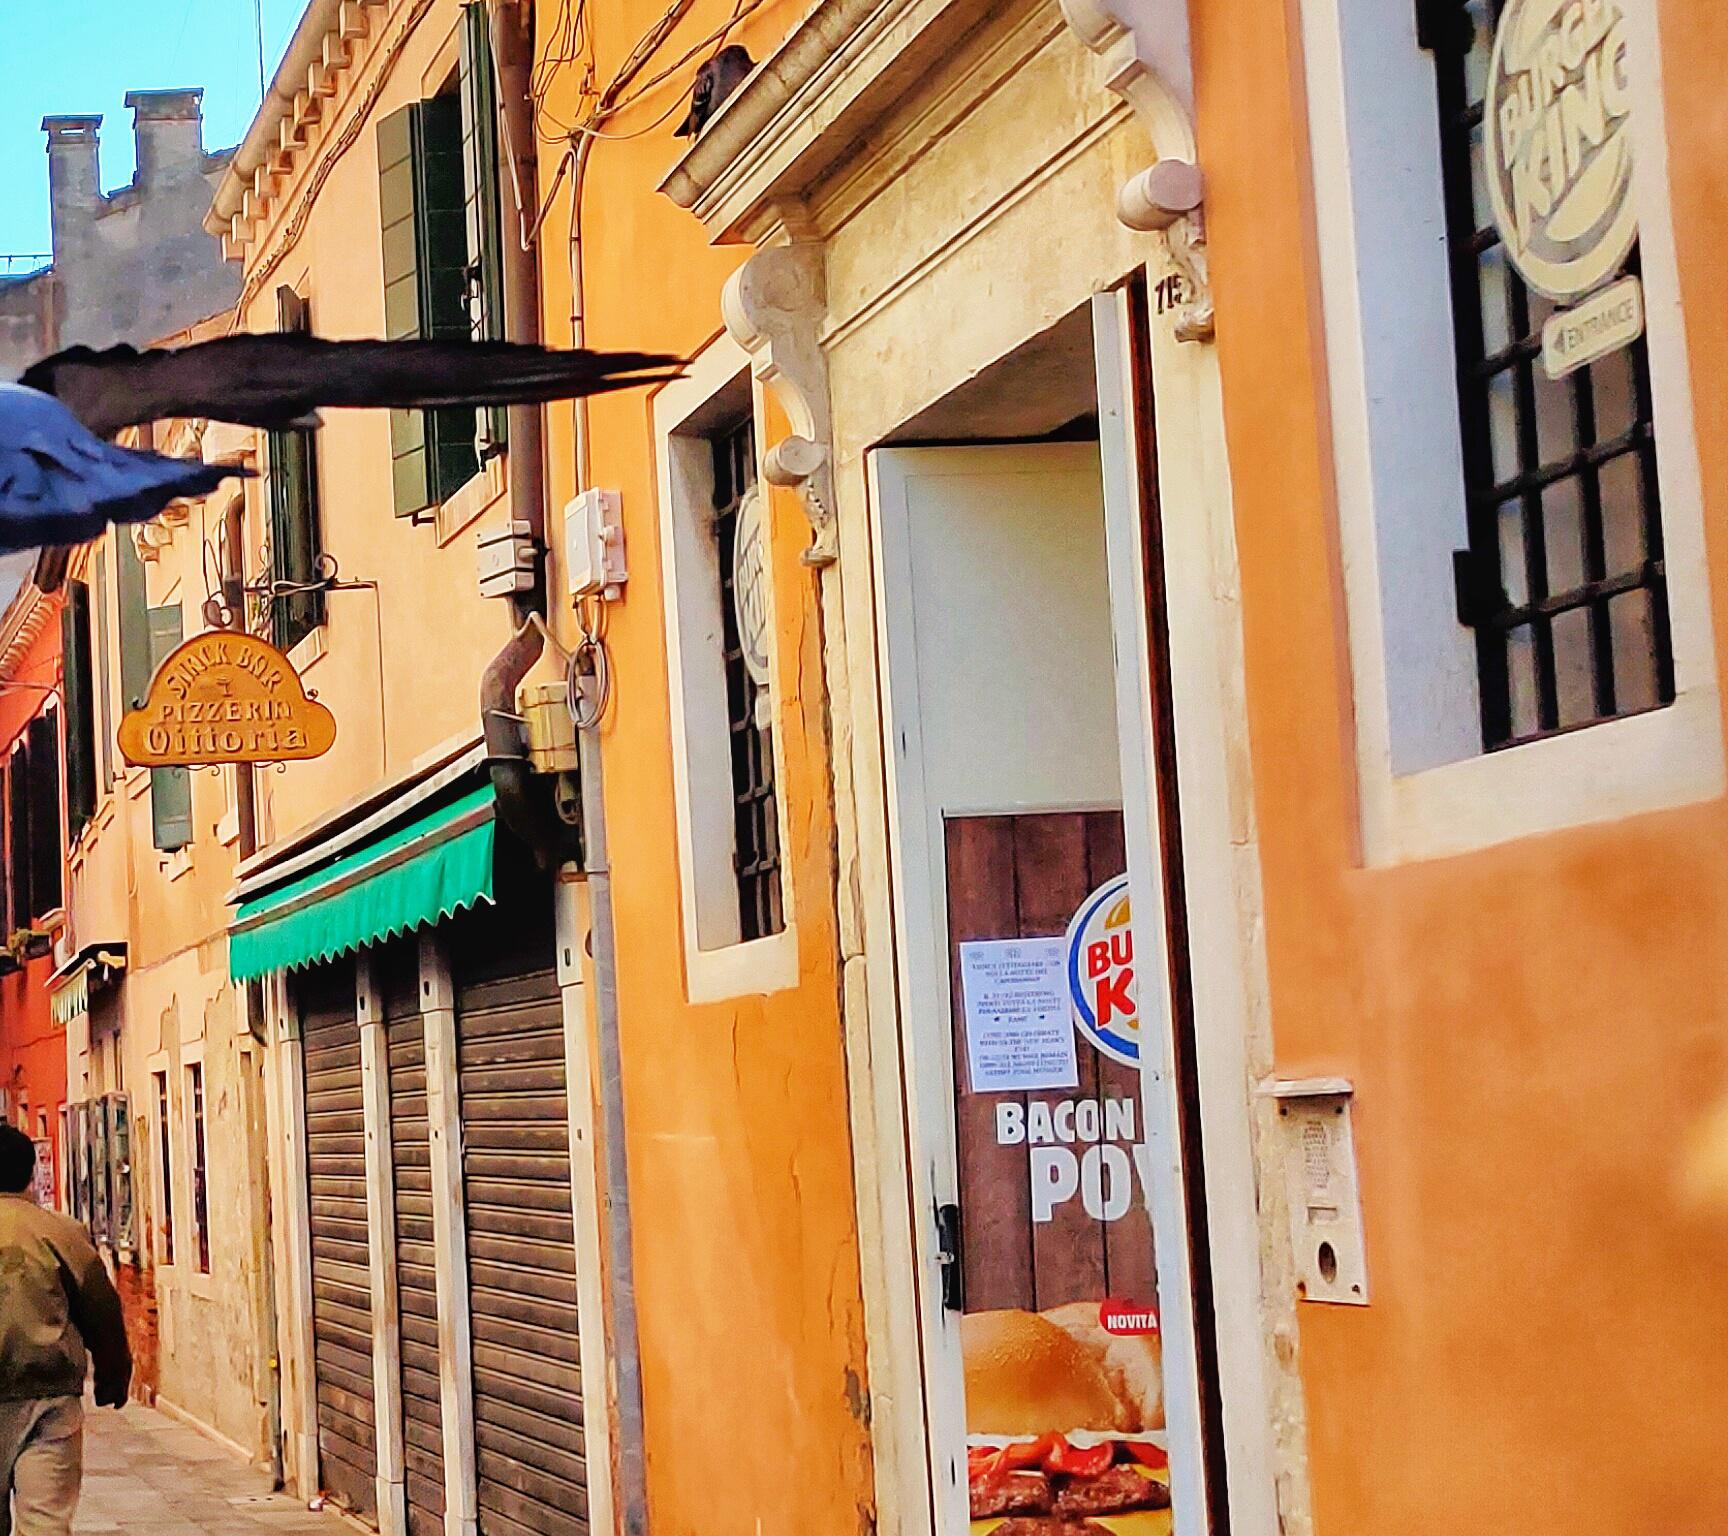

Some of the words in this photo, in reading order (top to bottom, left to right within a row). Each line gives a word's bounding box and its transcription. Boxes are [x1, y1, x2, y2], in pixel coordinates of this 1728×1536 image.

[167, 642, 231, 700] SNACK
[236, 647, 283, 693] BAR
[161, 700, 293, 723] PIZZERIA
[1087, 930, 1134, 979] BU
[1096, 968, 1137, 1028] K
[996, 1098, 1136, 1145] BACON
